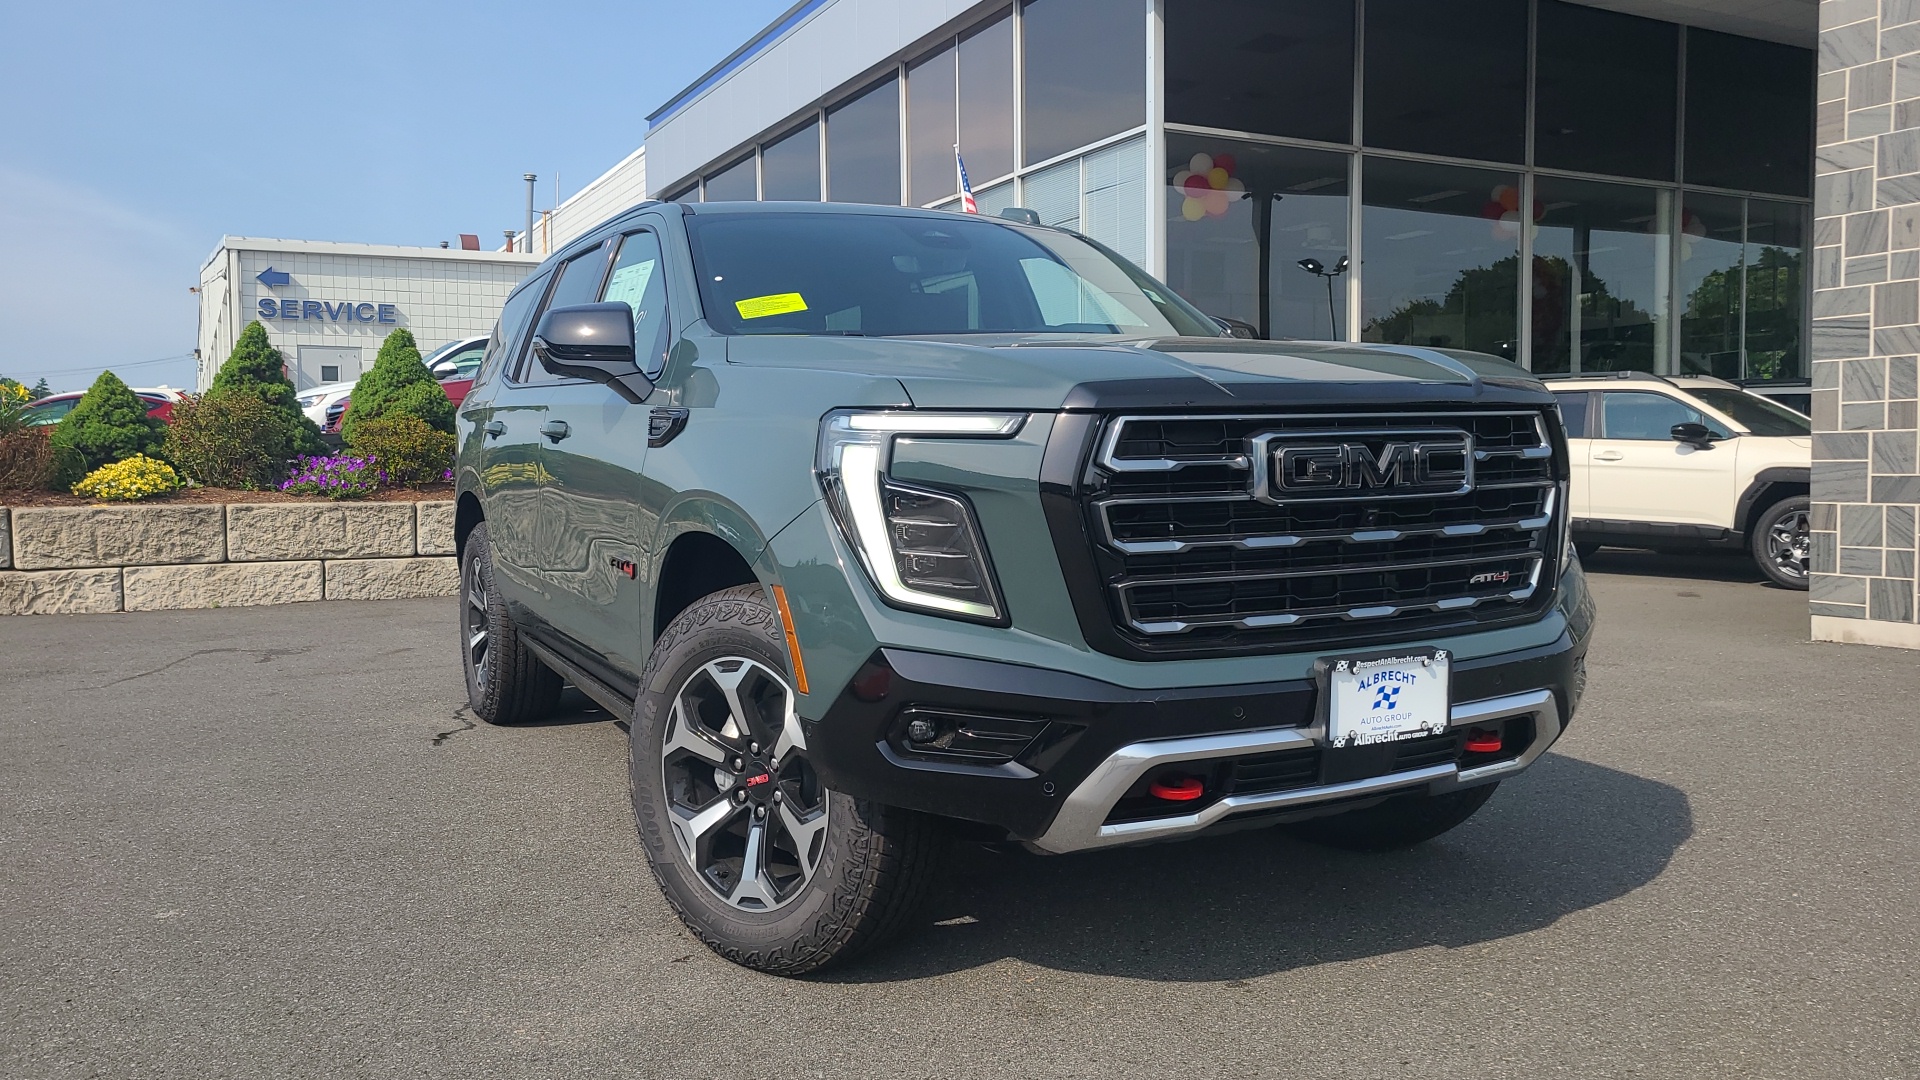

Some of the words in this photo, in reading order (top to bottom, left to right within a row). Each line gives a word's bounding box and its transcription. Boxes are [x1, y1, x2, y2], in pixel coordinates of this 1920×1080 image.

[257, 298, 396, 324] SERVICE
[1274, 441, 1465, 491] GMC
[610, 557, 637, 579] AT4
[1470, 570, 1509, 584] AT4
[1356, 655, 1428, 669] RespectAtAlbrecht.com
[1357, 671, 1417, 692] ALBRECHT
[1360, 715, 1382, 725] AUTO
[1384, 712, 1412, 723] GROUP
[1354, 730, 1399, 746] Albrecht
[1412, 731, 1428, 739] GROUP
